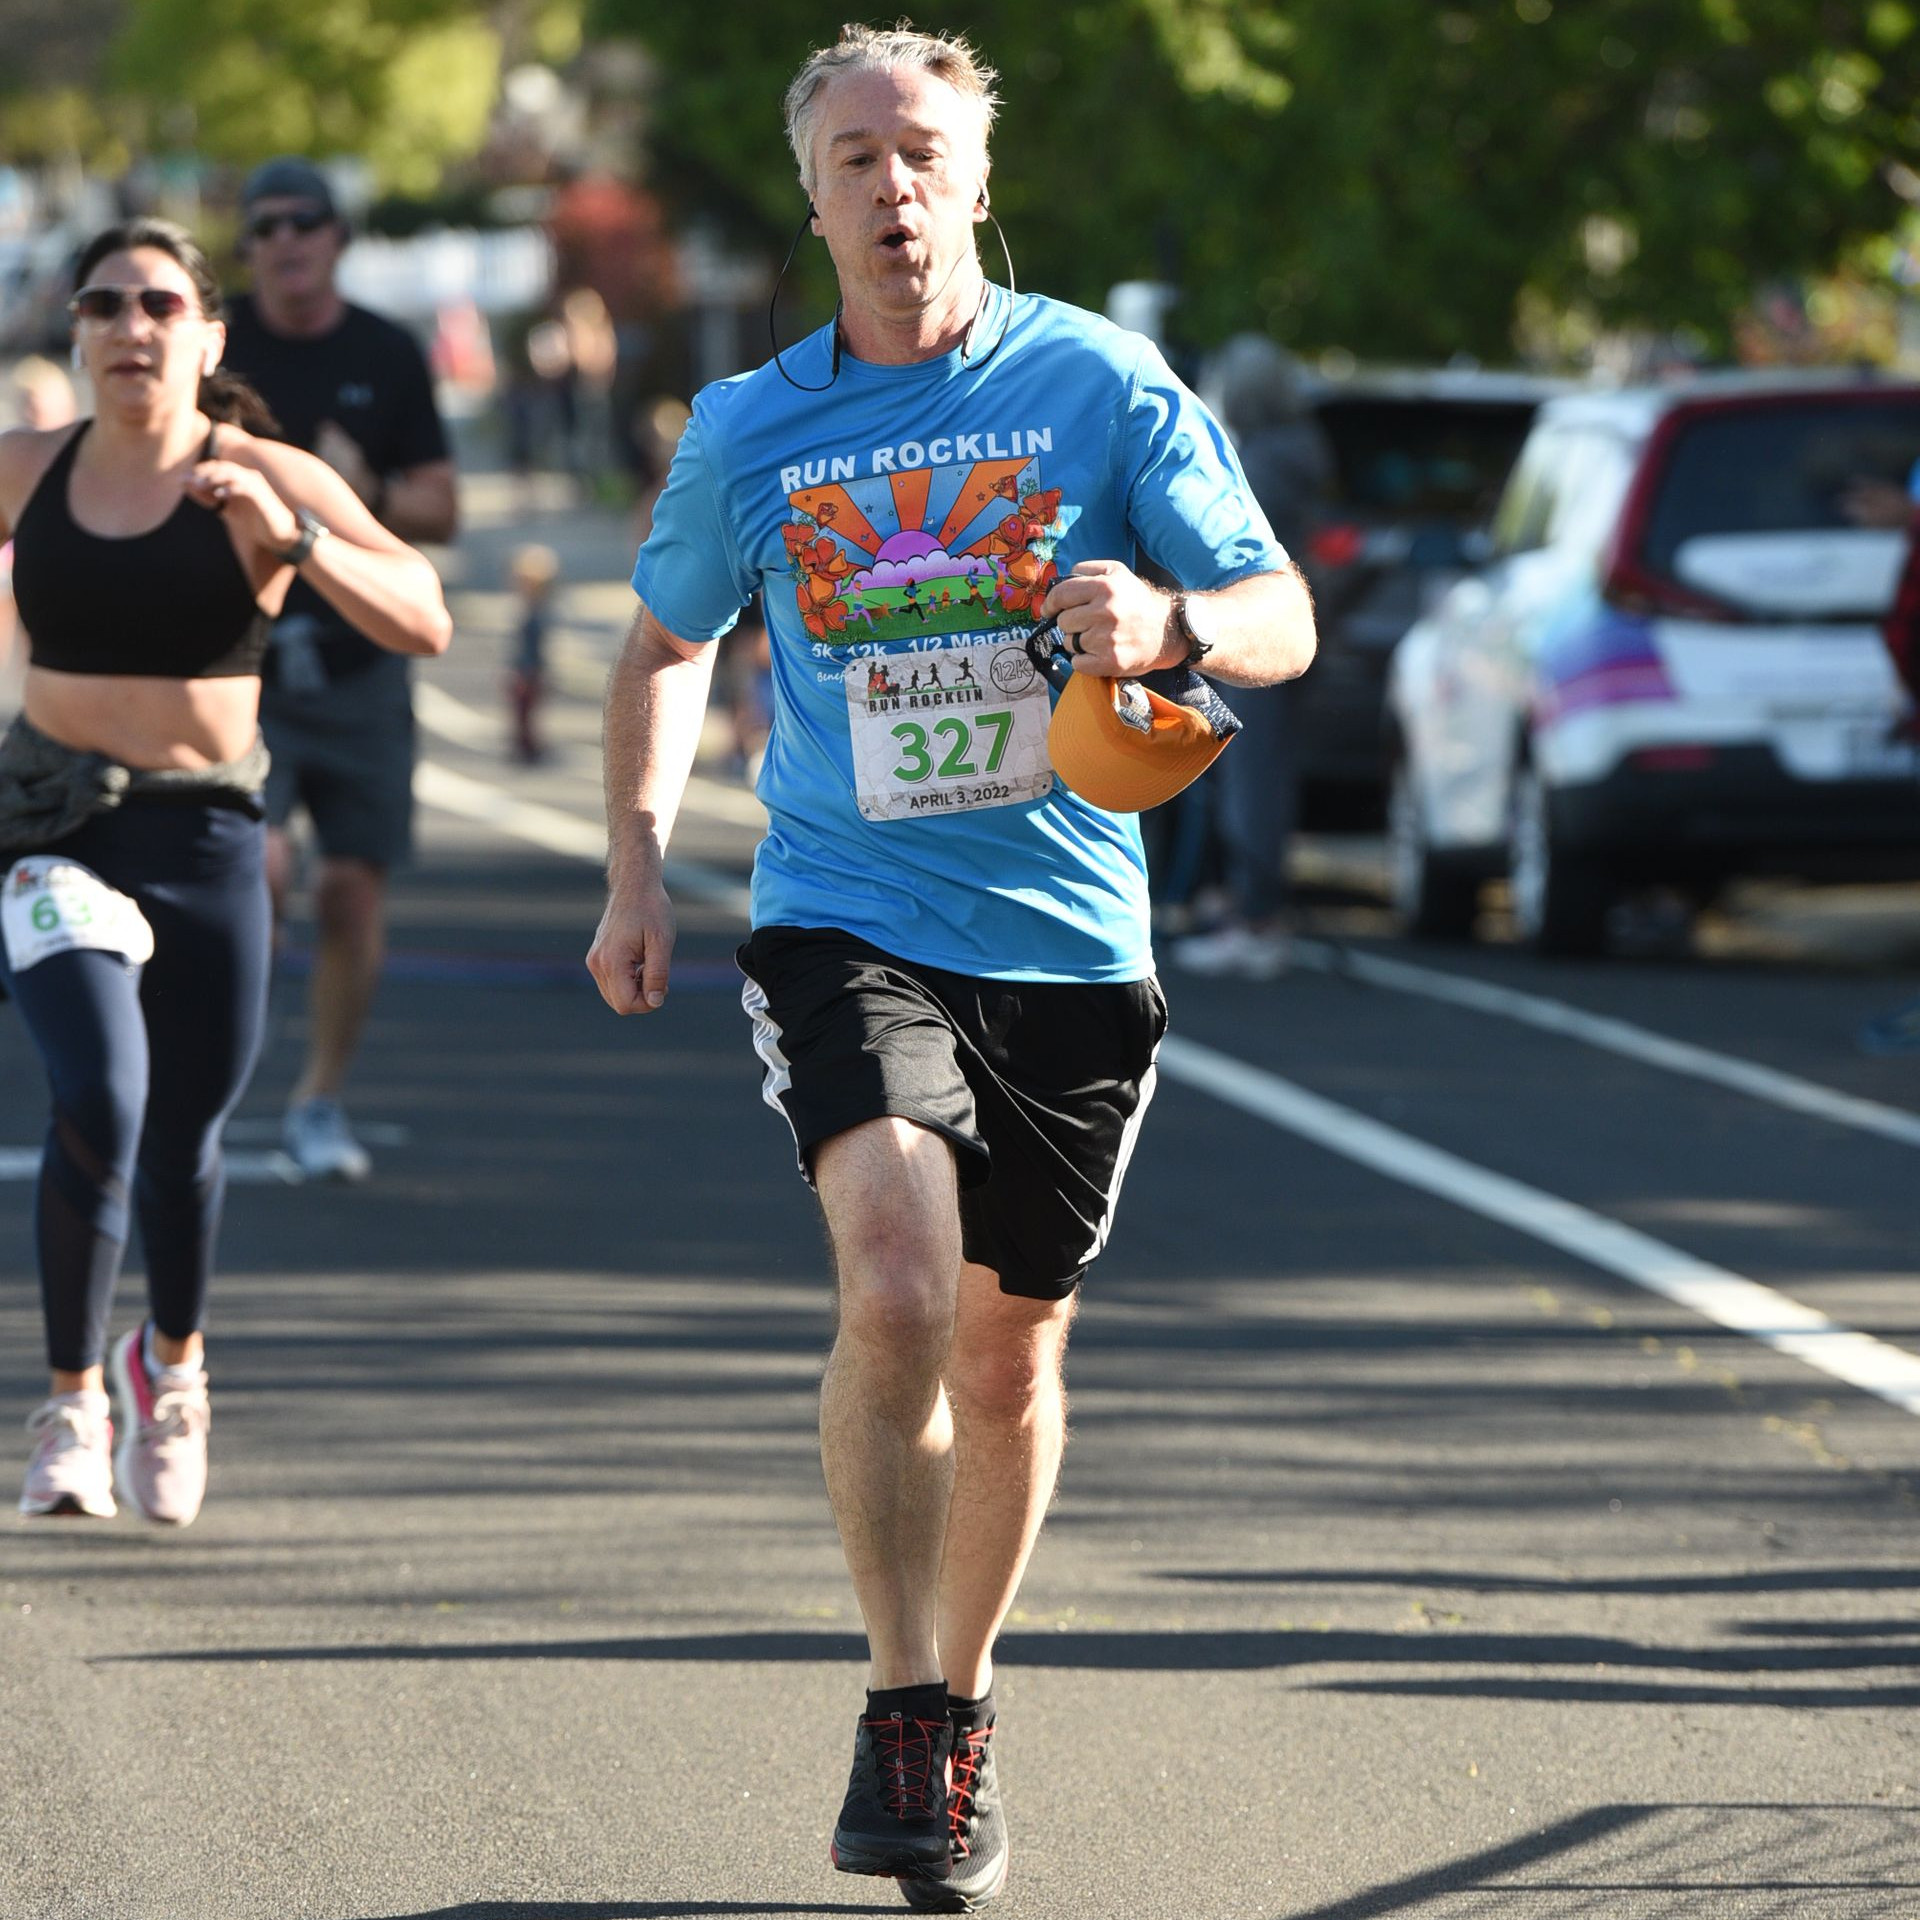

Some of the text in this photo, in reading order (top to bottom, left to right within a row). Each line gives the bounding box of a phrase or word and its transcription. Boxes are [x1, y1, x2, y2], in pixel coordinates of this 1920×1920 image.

[780, 427, 1053, 494] RUN ROCKLIN
[811, 642, 833, 658] 5k
[908, 637, 945, 653] 1/2
[951, 626, 1036, 648] Marath
[816, 671, 846, 684] Benef
[993, 658, 1033, 682] 12K
[869, 688, 984, 712] RUN ROCKLIN
[890, 710, 1014, 784] 327
[910, 793, 953, 809] APRIL
[957, 791, 971, 804] 3,
[974, 785, 1010, 801] 2022
